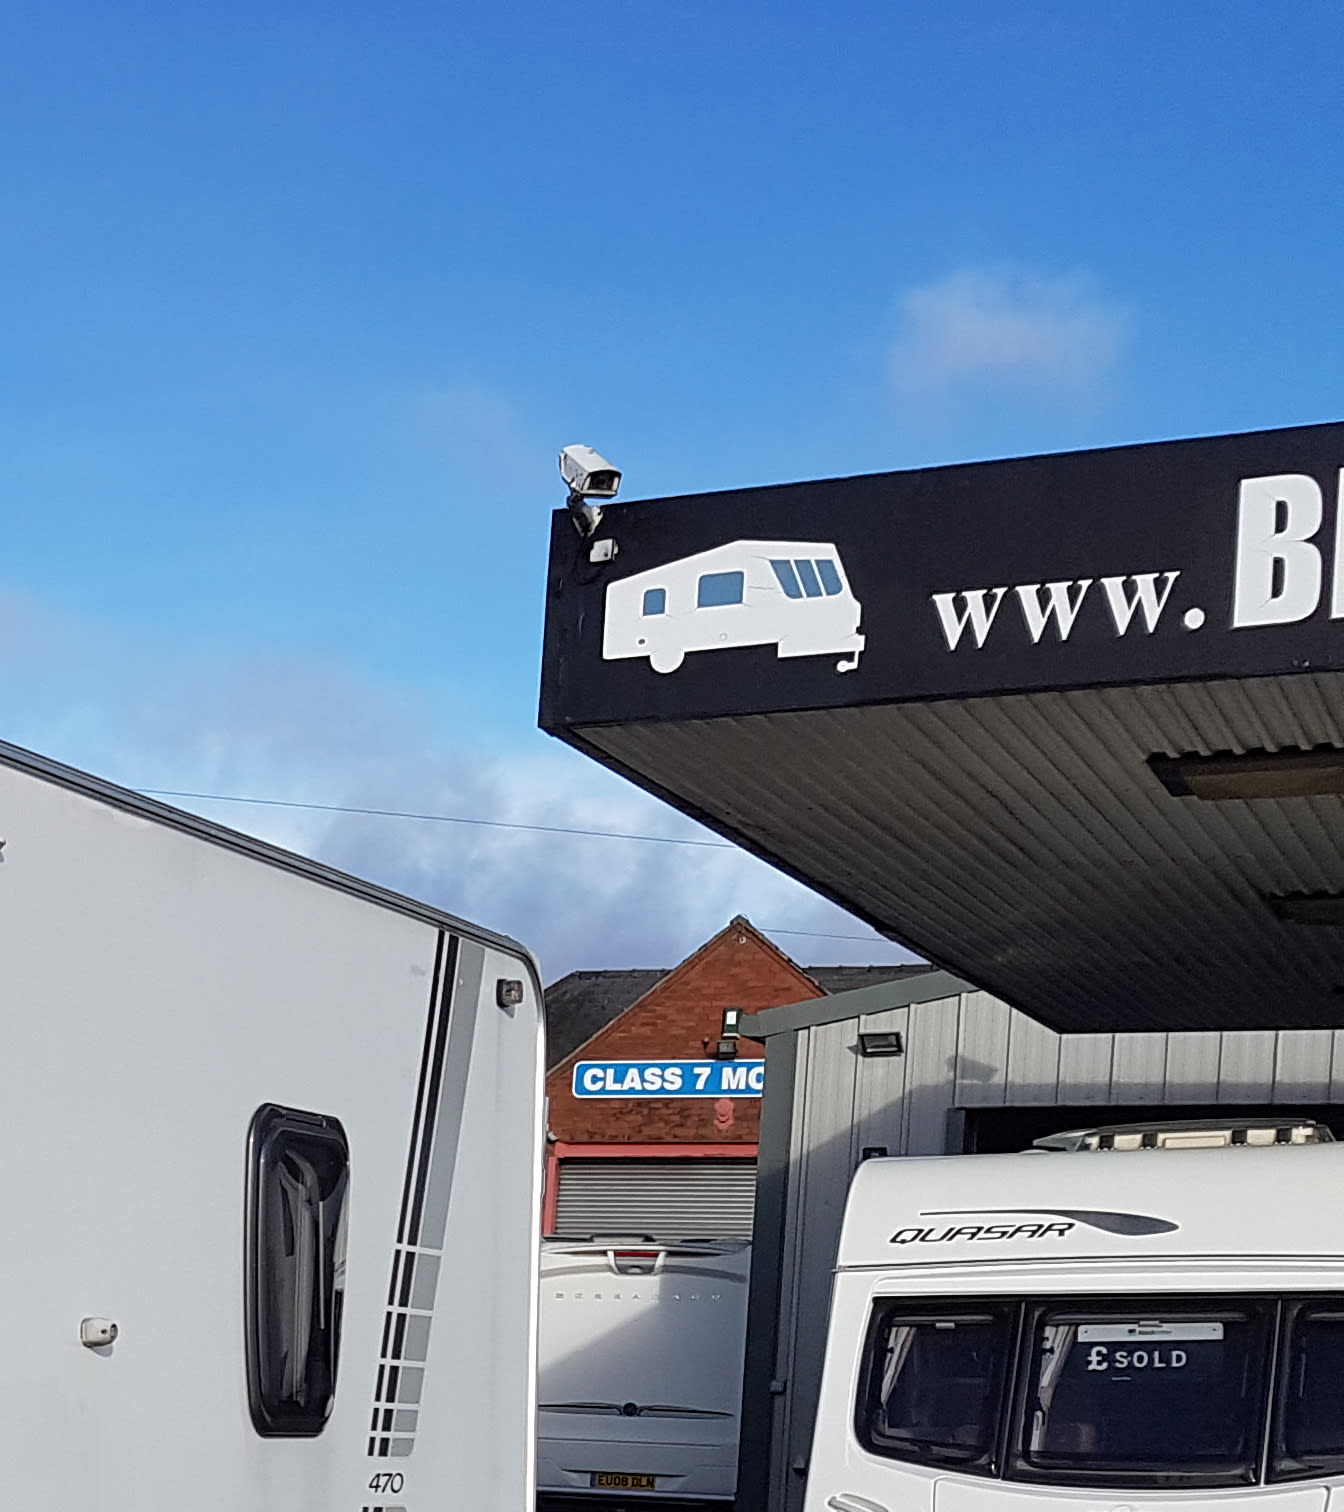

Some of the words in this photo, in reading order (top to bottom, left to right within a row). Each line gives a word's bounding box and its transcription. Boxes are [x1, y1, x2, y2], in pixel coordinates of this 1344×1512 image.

[583, 1067, 682, 1091] CLASS
[693, 1067, 712, 1090] 7
[889, 1222, 1076, 1245] QUASAR
[368, 1472, 405, 1494] 470
